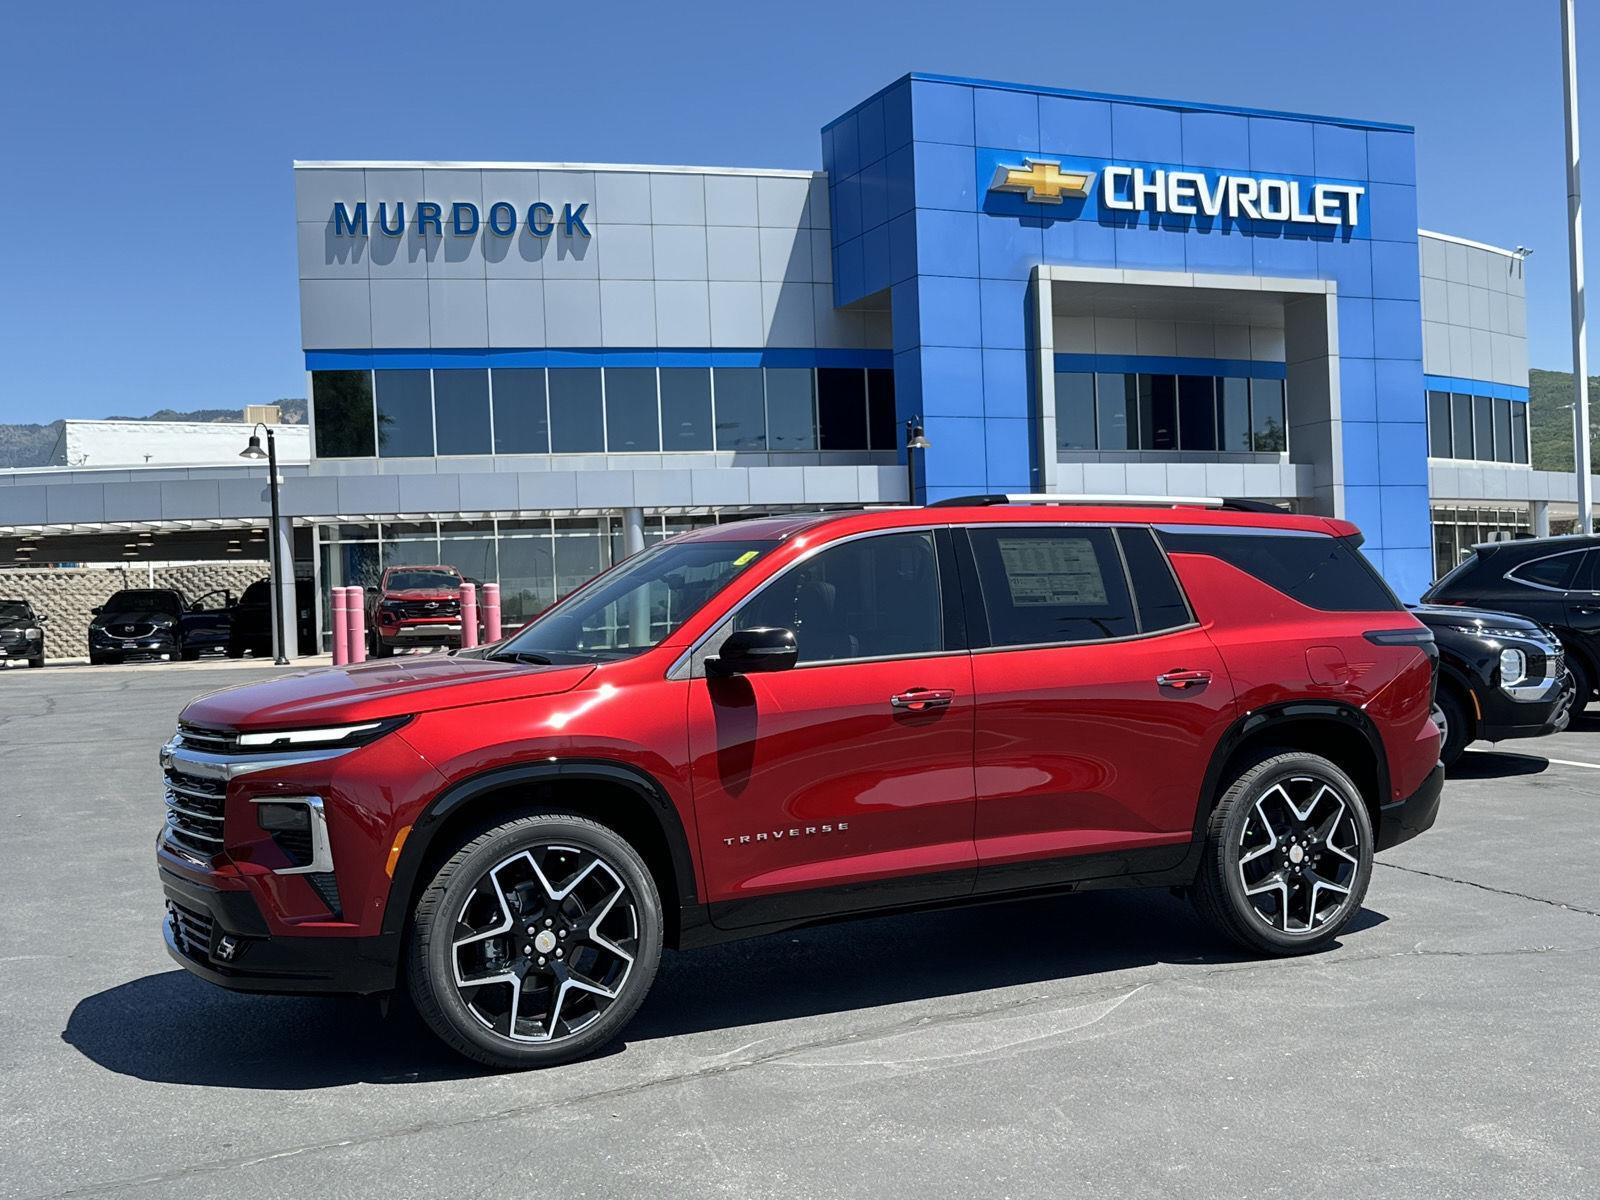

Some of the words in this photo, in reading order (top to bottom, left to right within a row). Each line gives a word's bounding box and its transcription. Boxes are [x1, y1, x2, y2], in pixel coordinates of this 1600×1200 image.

[1103, 166, 1365, 226] CHEVROLET
[334, 202, 592, 237] MURDOCK
[723, 822, 849, 846] TRAVERSE
